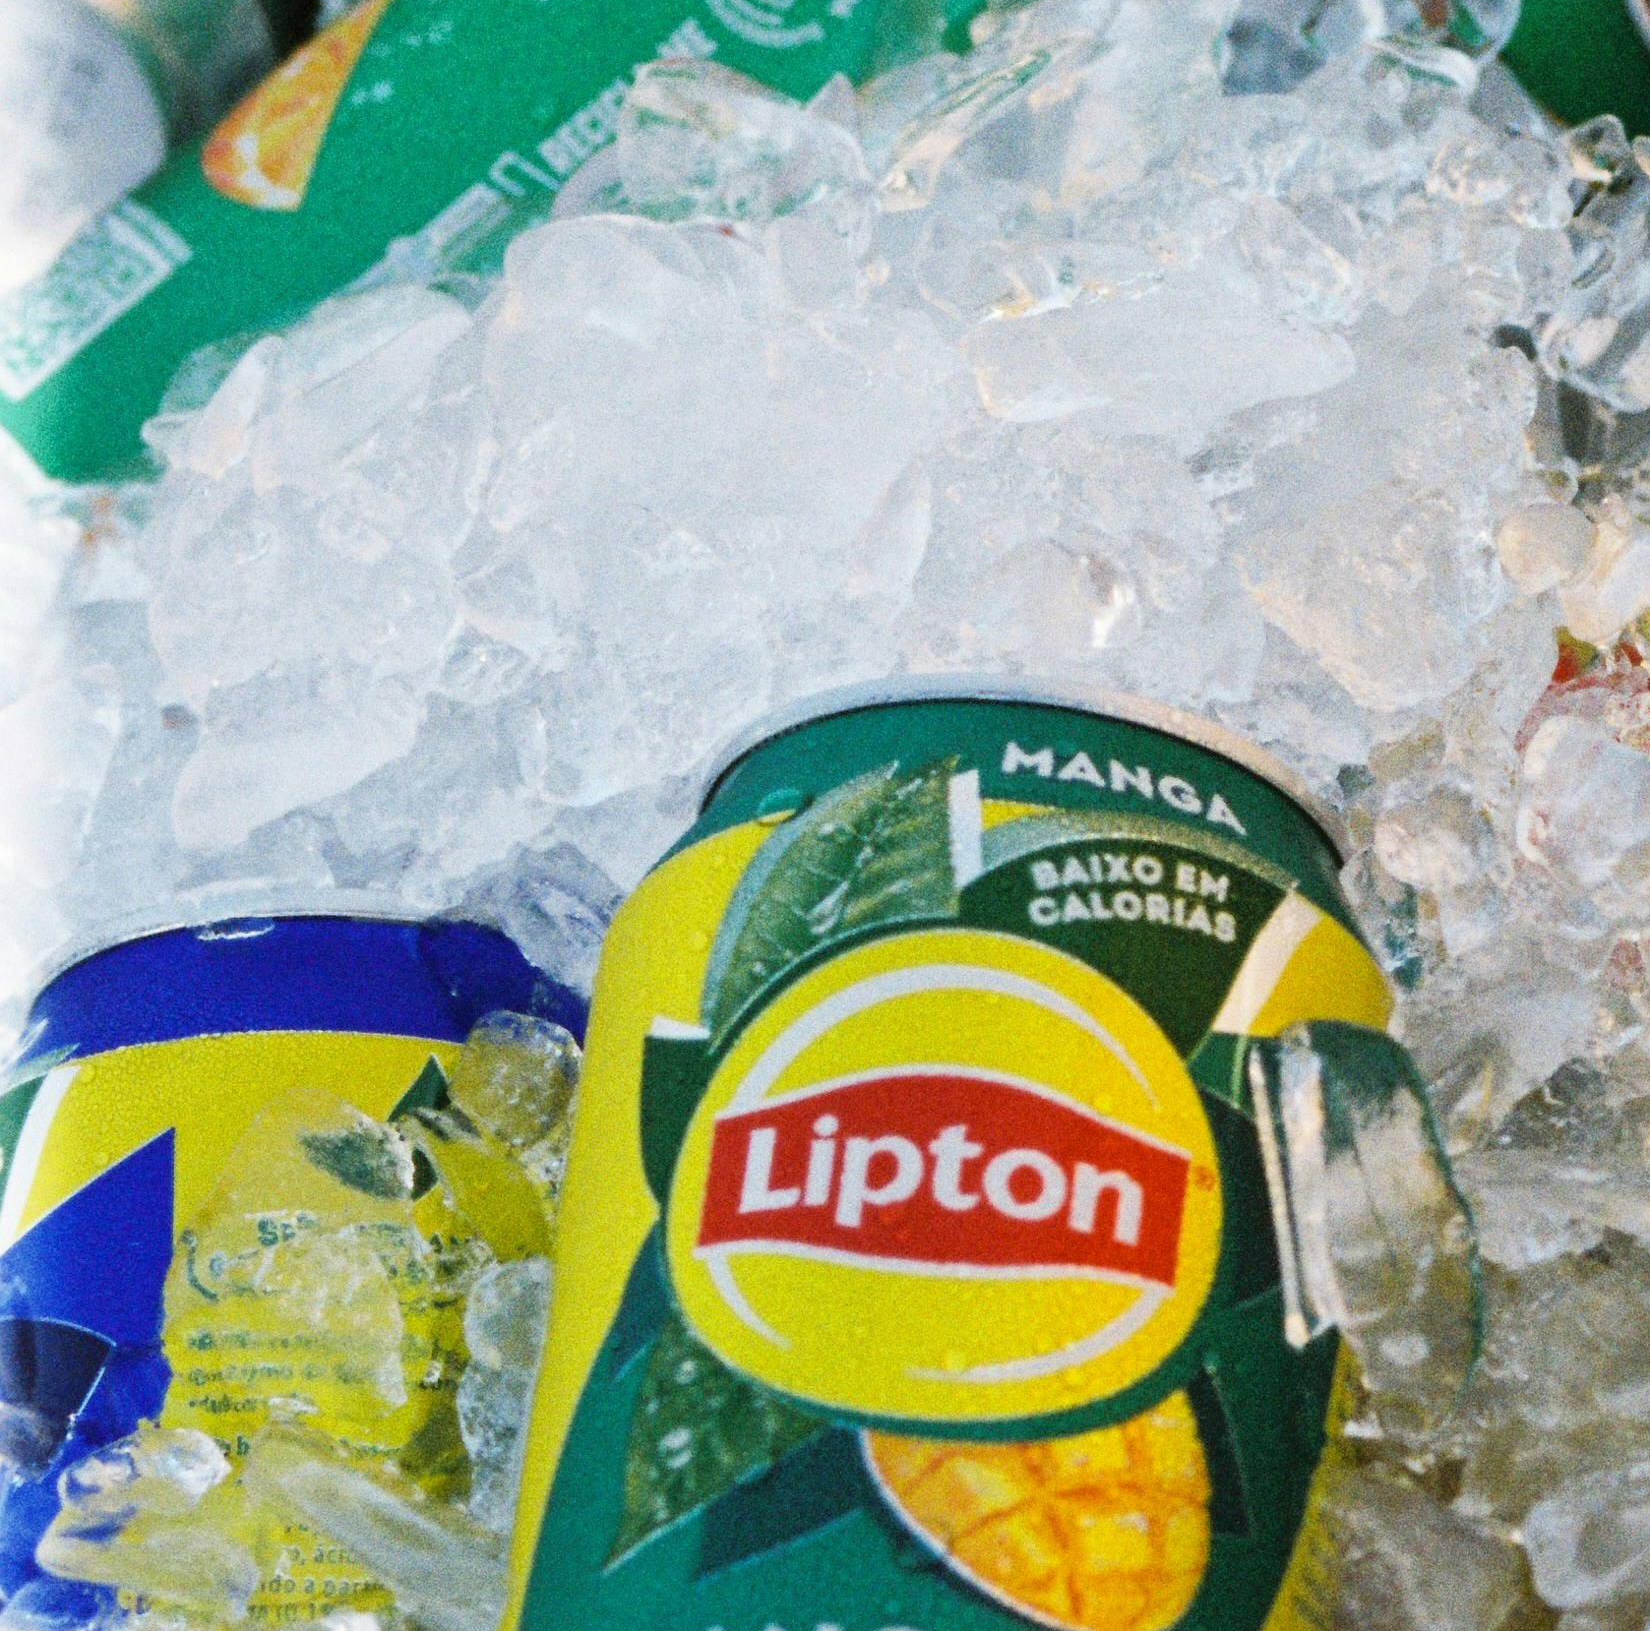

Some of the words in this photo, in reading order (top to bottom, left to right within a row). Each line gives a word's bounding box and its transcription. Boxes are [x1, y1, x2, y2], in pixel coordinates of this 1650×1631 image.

[1000, 741, 1247, 837] MANGA
[1030, 856, 1163, 892] BAIXO
[1175, 863, 1230, 900] EM
[1028, 894, 1238, 944] CALORIAS
[737, 1113, 1145, 1245] Lipton
